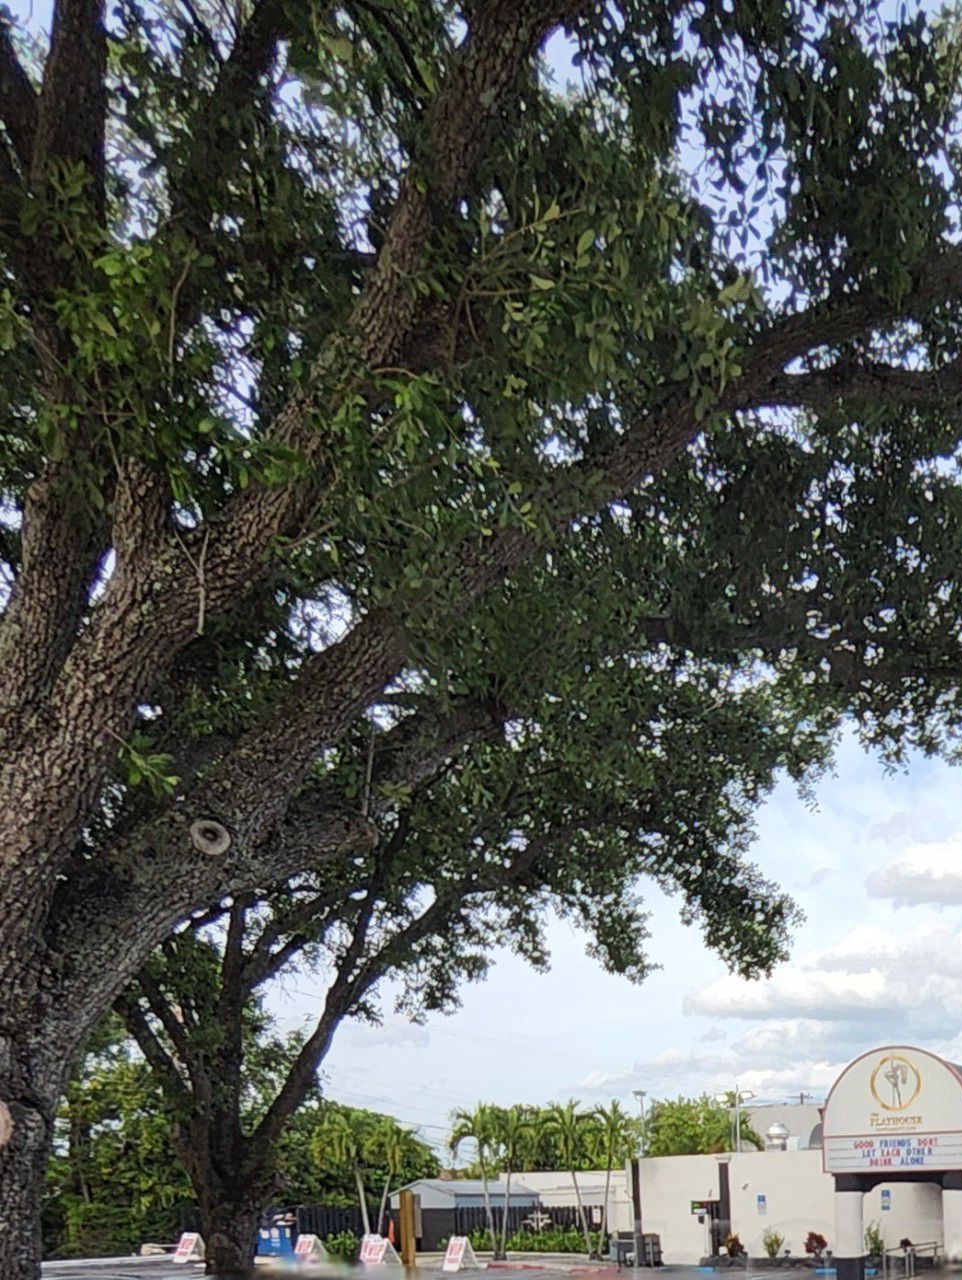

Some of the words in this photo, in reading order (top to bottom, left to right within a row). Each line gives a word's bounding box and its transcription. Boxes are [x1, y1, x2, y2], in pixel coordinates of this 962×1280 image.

[870, 1116, 923, 1126] PLAYHOUSE
[853, 1140, 875, 1149] GOOD
[879, 1138, 911, 1148] FRIENDS
[862, 1149, 876, 1158] LET
[880, 1148, 901, 1157] EACH
[869, 1158, 892, 1167] DRINK
[900, 1157, 924, 1165] ALONE
